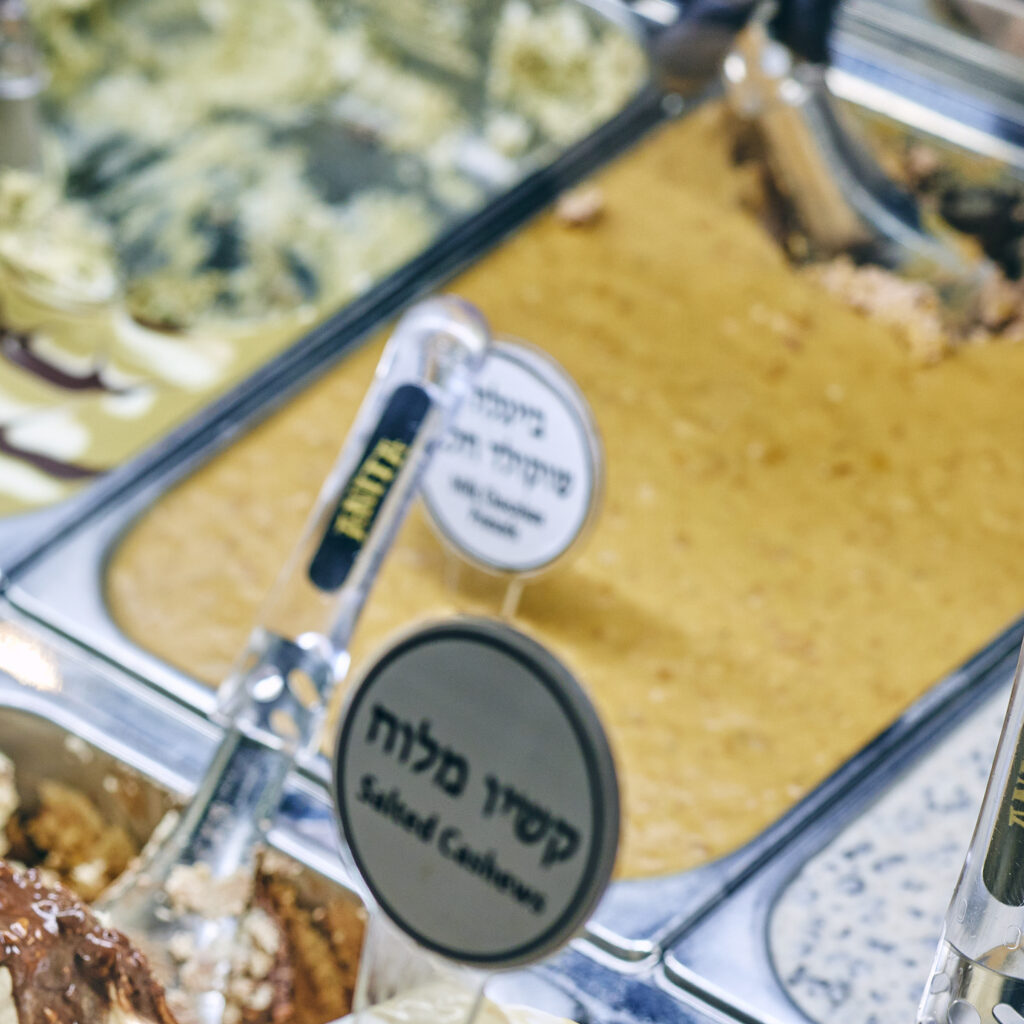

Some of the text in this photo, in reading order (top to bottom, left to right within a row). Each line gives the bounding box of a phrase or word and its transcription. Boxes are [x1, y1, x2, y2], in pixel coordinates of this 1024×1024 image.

[365, 703, 470, 797] מלוח
[357, 774, 546, 914] Salted Cashews
